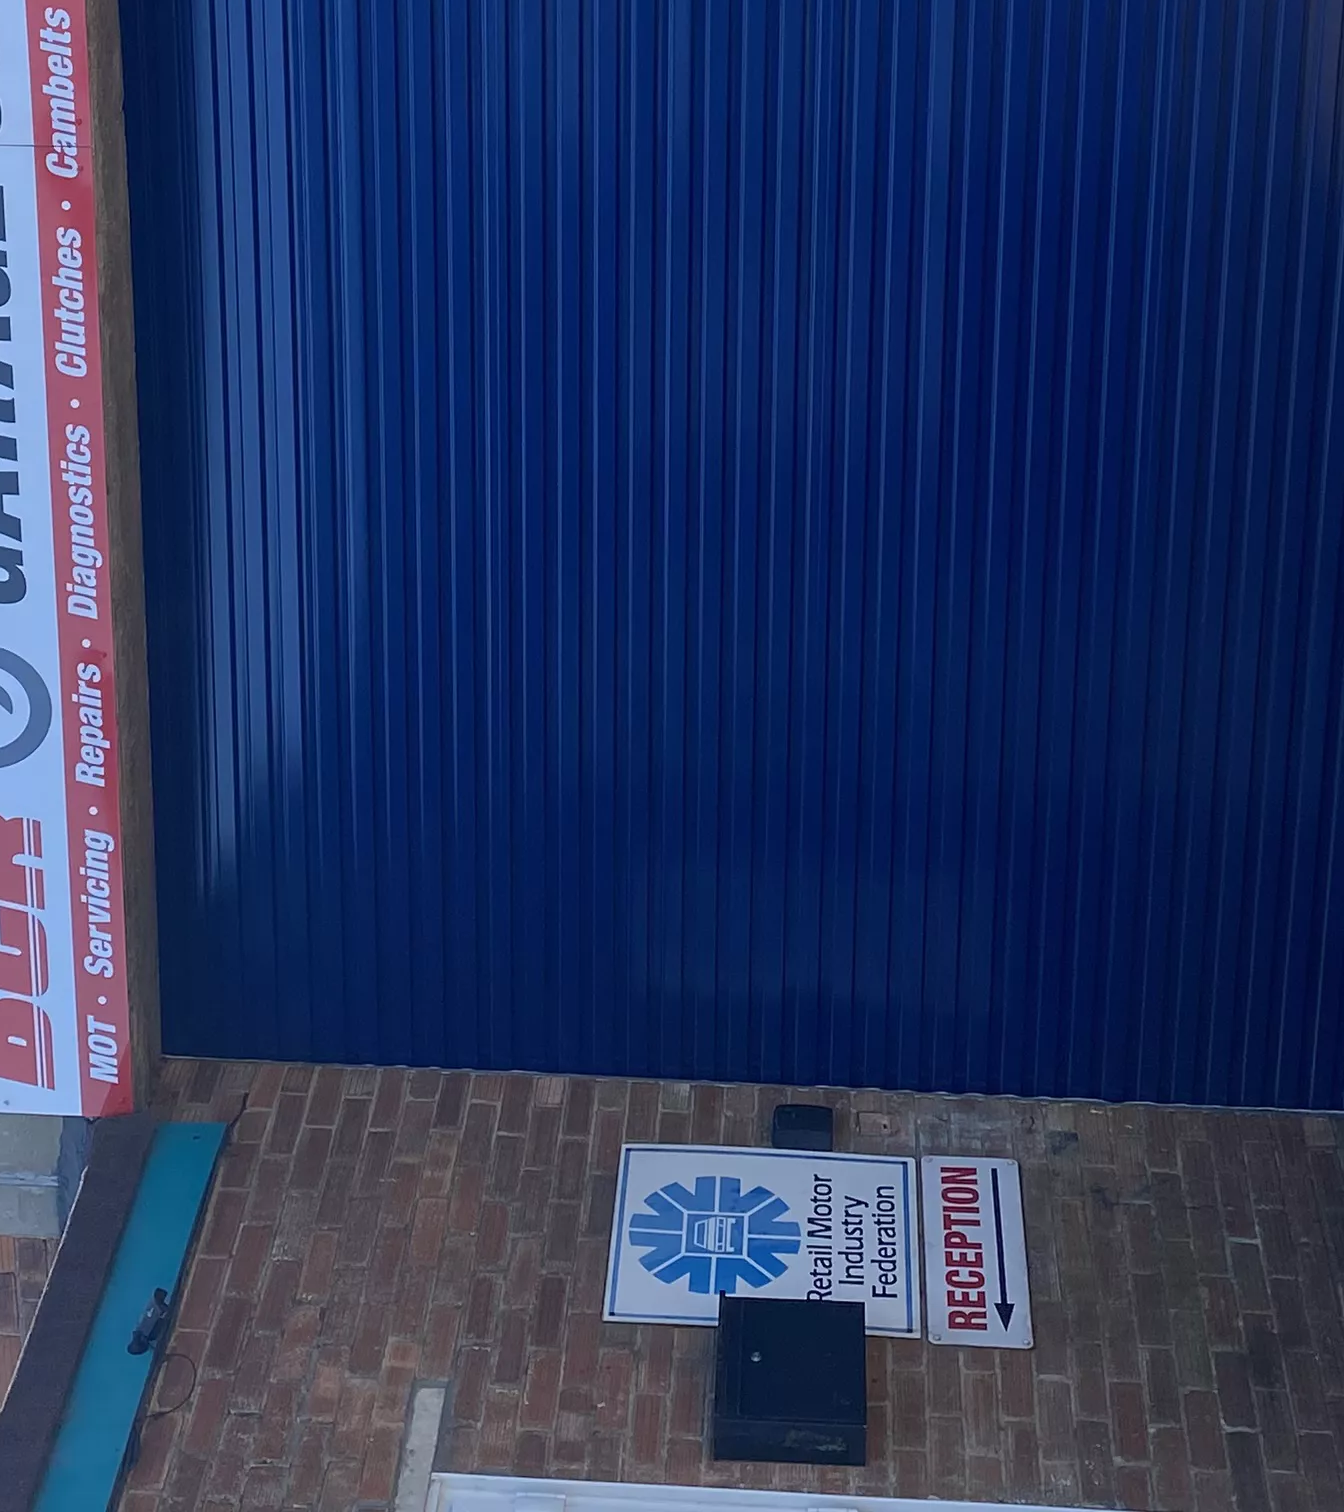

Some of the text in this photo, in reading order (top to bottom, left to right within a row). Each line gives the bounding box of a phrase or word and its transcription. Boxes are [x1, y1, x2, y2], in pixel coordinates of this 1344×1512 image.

[43, 7, 78, 178] Cambelts
[52, 227, 87, 377] Clutches
[60, 424, 102, 619] Diagnostics
[73, 662, 110, 787] Repairs
[80, 830, 114, 977] Servicing
[87, 1015, 118, 1083] MOT
[806, 1173, 833, 1302] Retail Motor
[838, 1195, 870, 1286] Industry
[871, 1185, 898, 1299] Federation
[940, 1166, 988, 1331] RECEPTION
